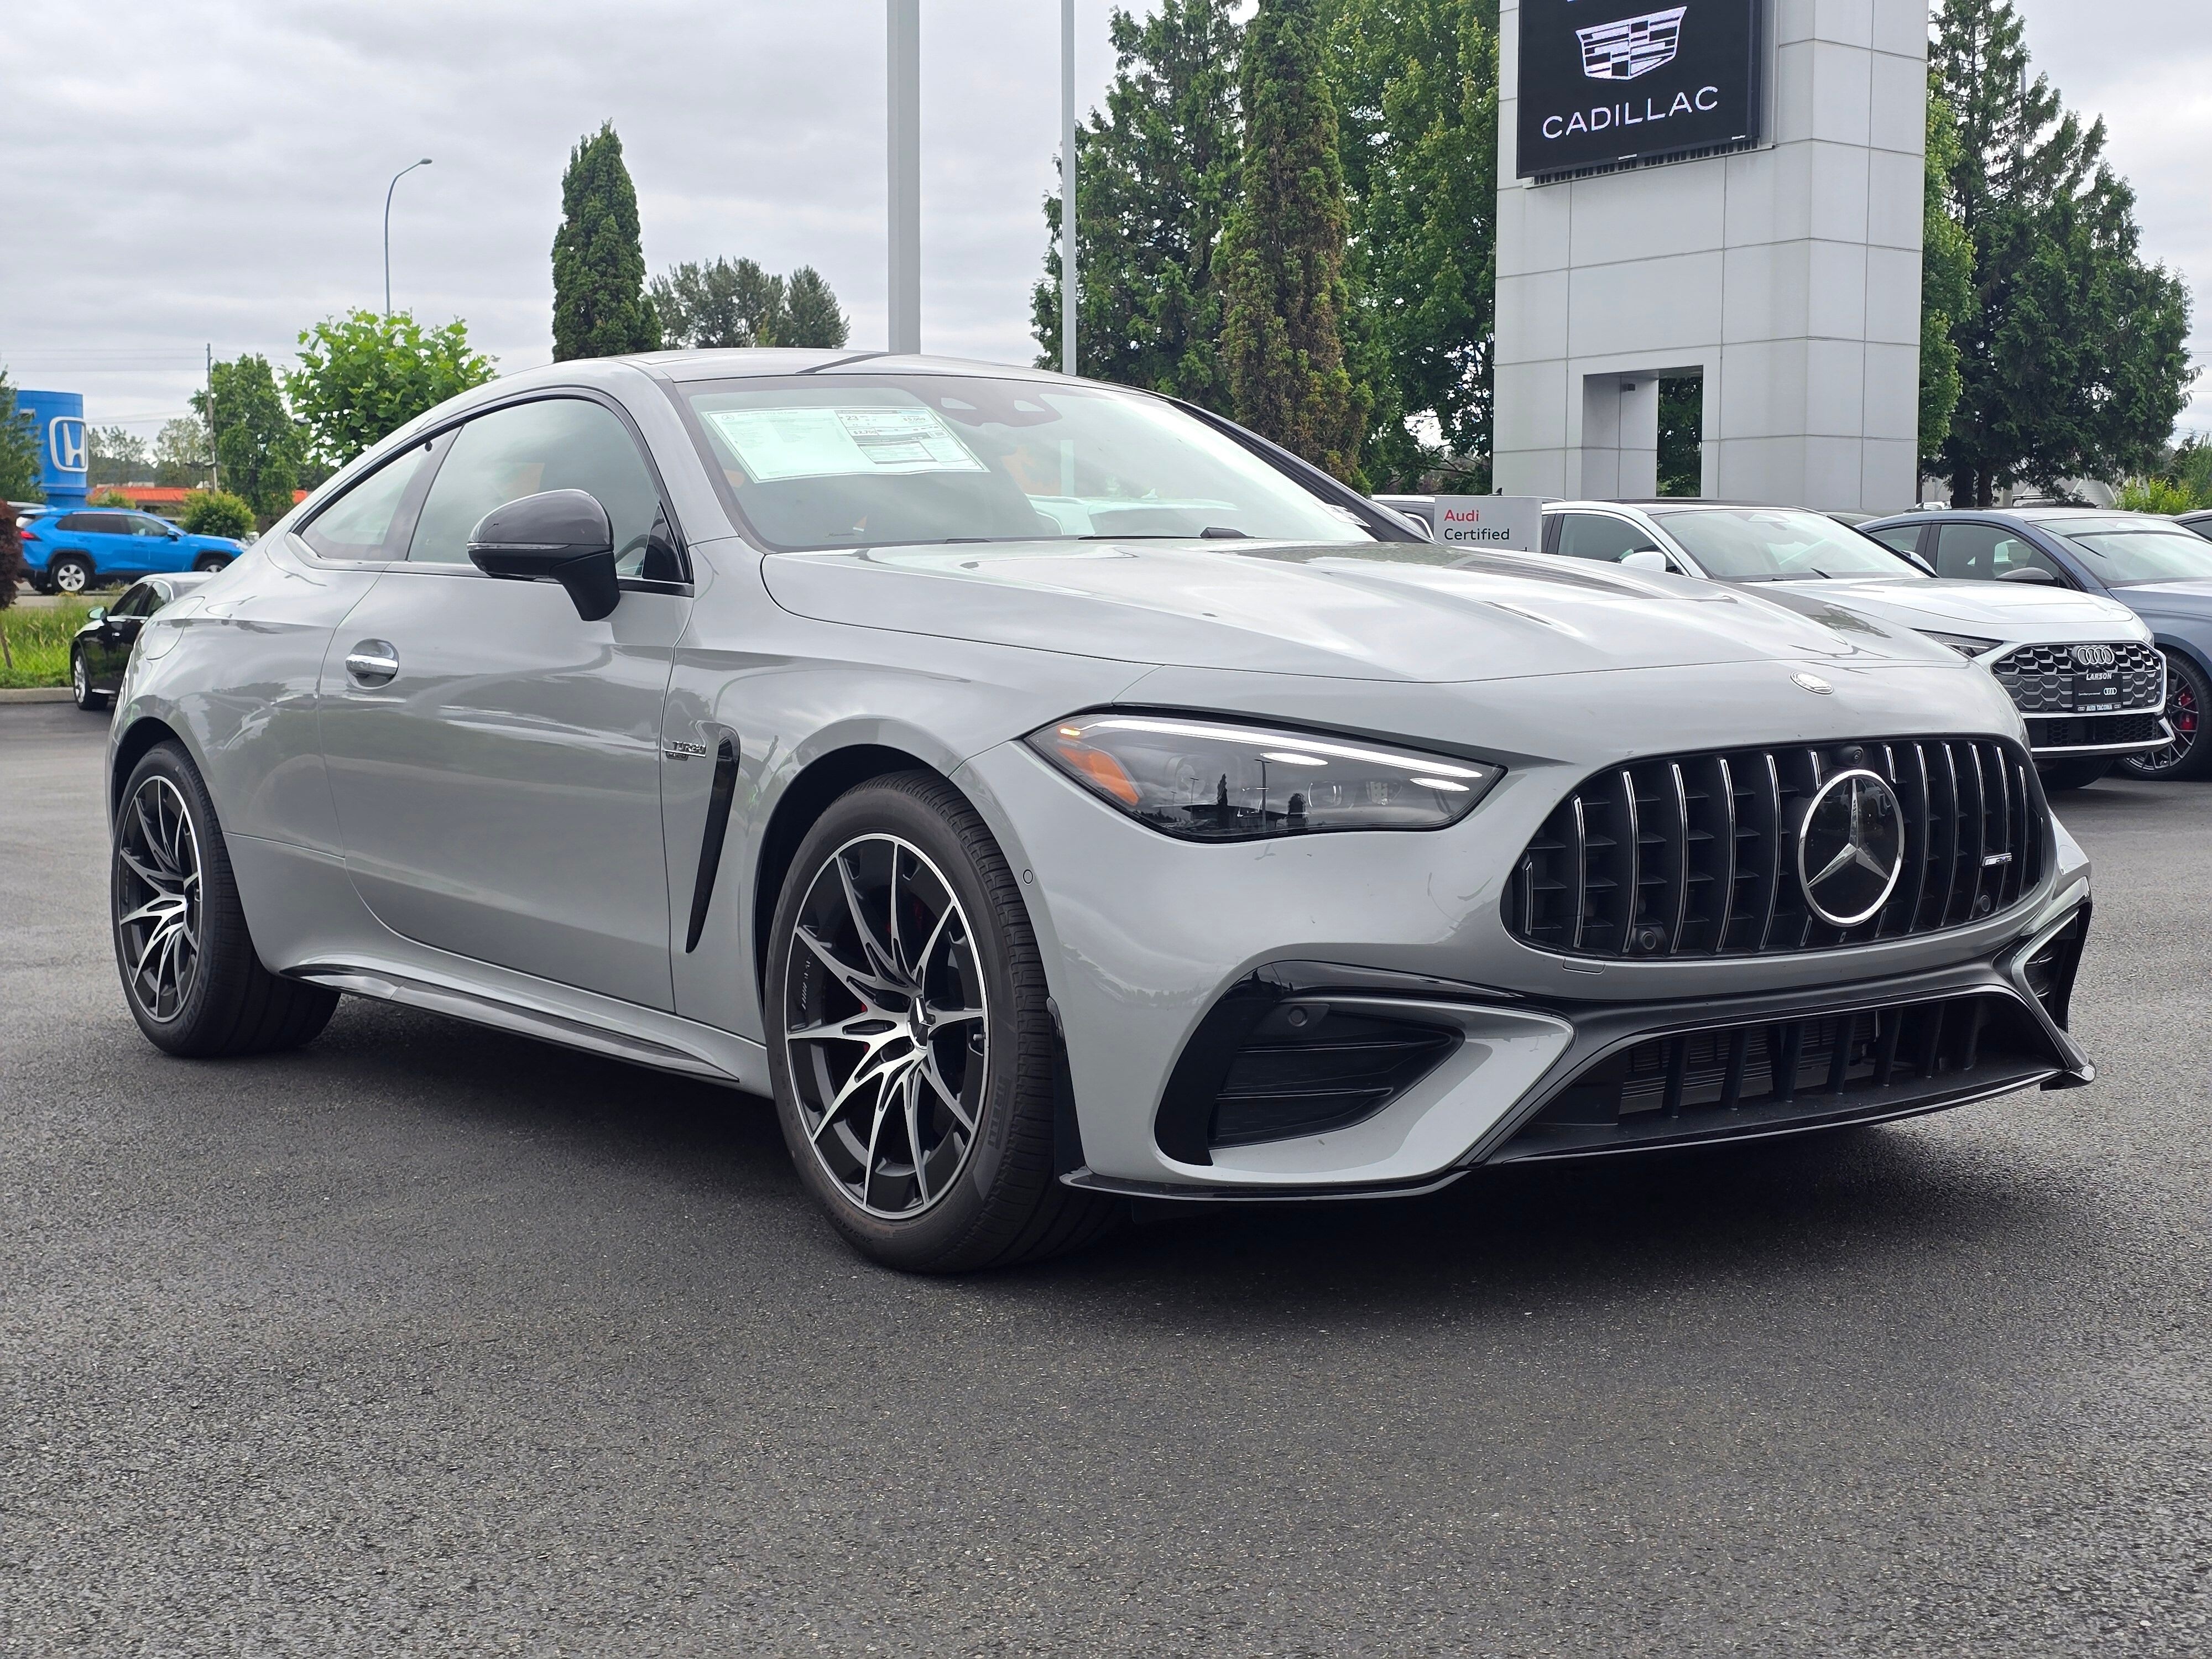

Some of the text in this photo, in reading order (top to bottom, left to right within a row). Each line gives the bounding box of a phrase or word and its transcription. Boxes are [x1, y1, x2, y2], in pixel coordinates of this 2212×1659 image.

[1542, 86, 1718, 139] CADILLAC
[1444, 509, 1479, 521] Audi
[1444, 528, 1510, 540] Certified
[2086, 672, 2112, 681] LARSON
